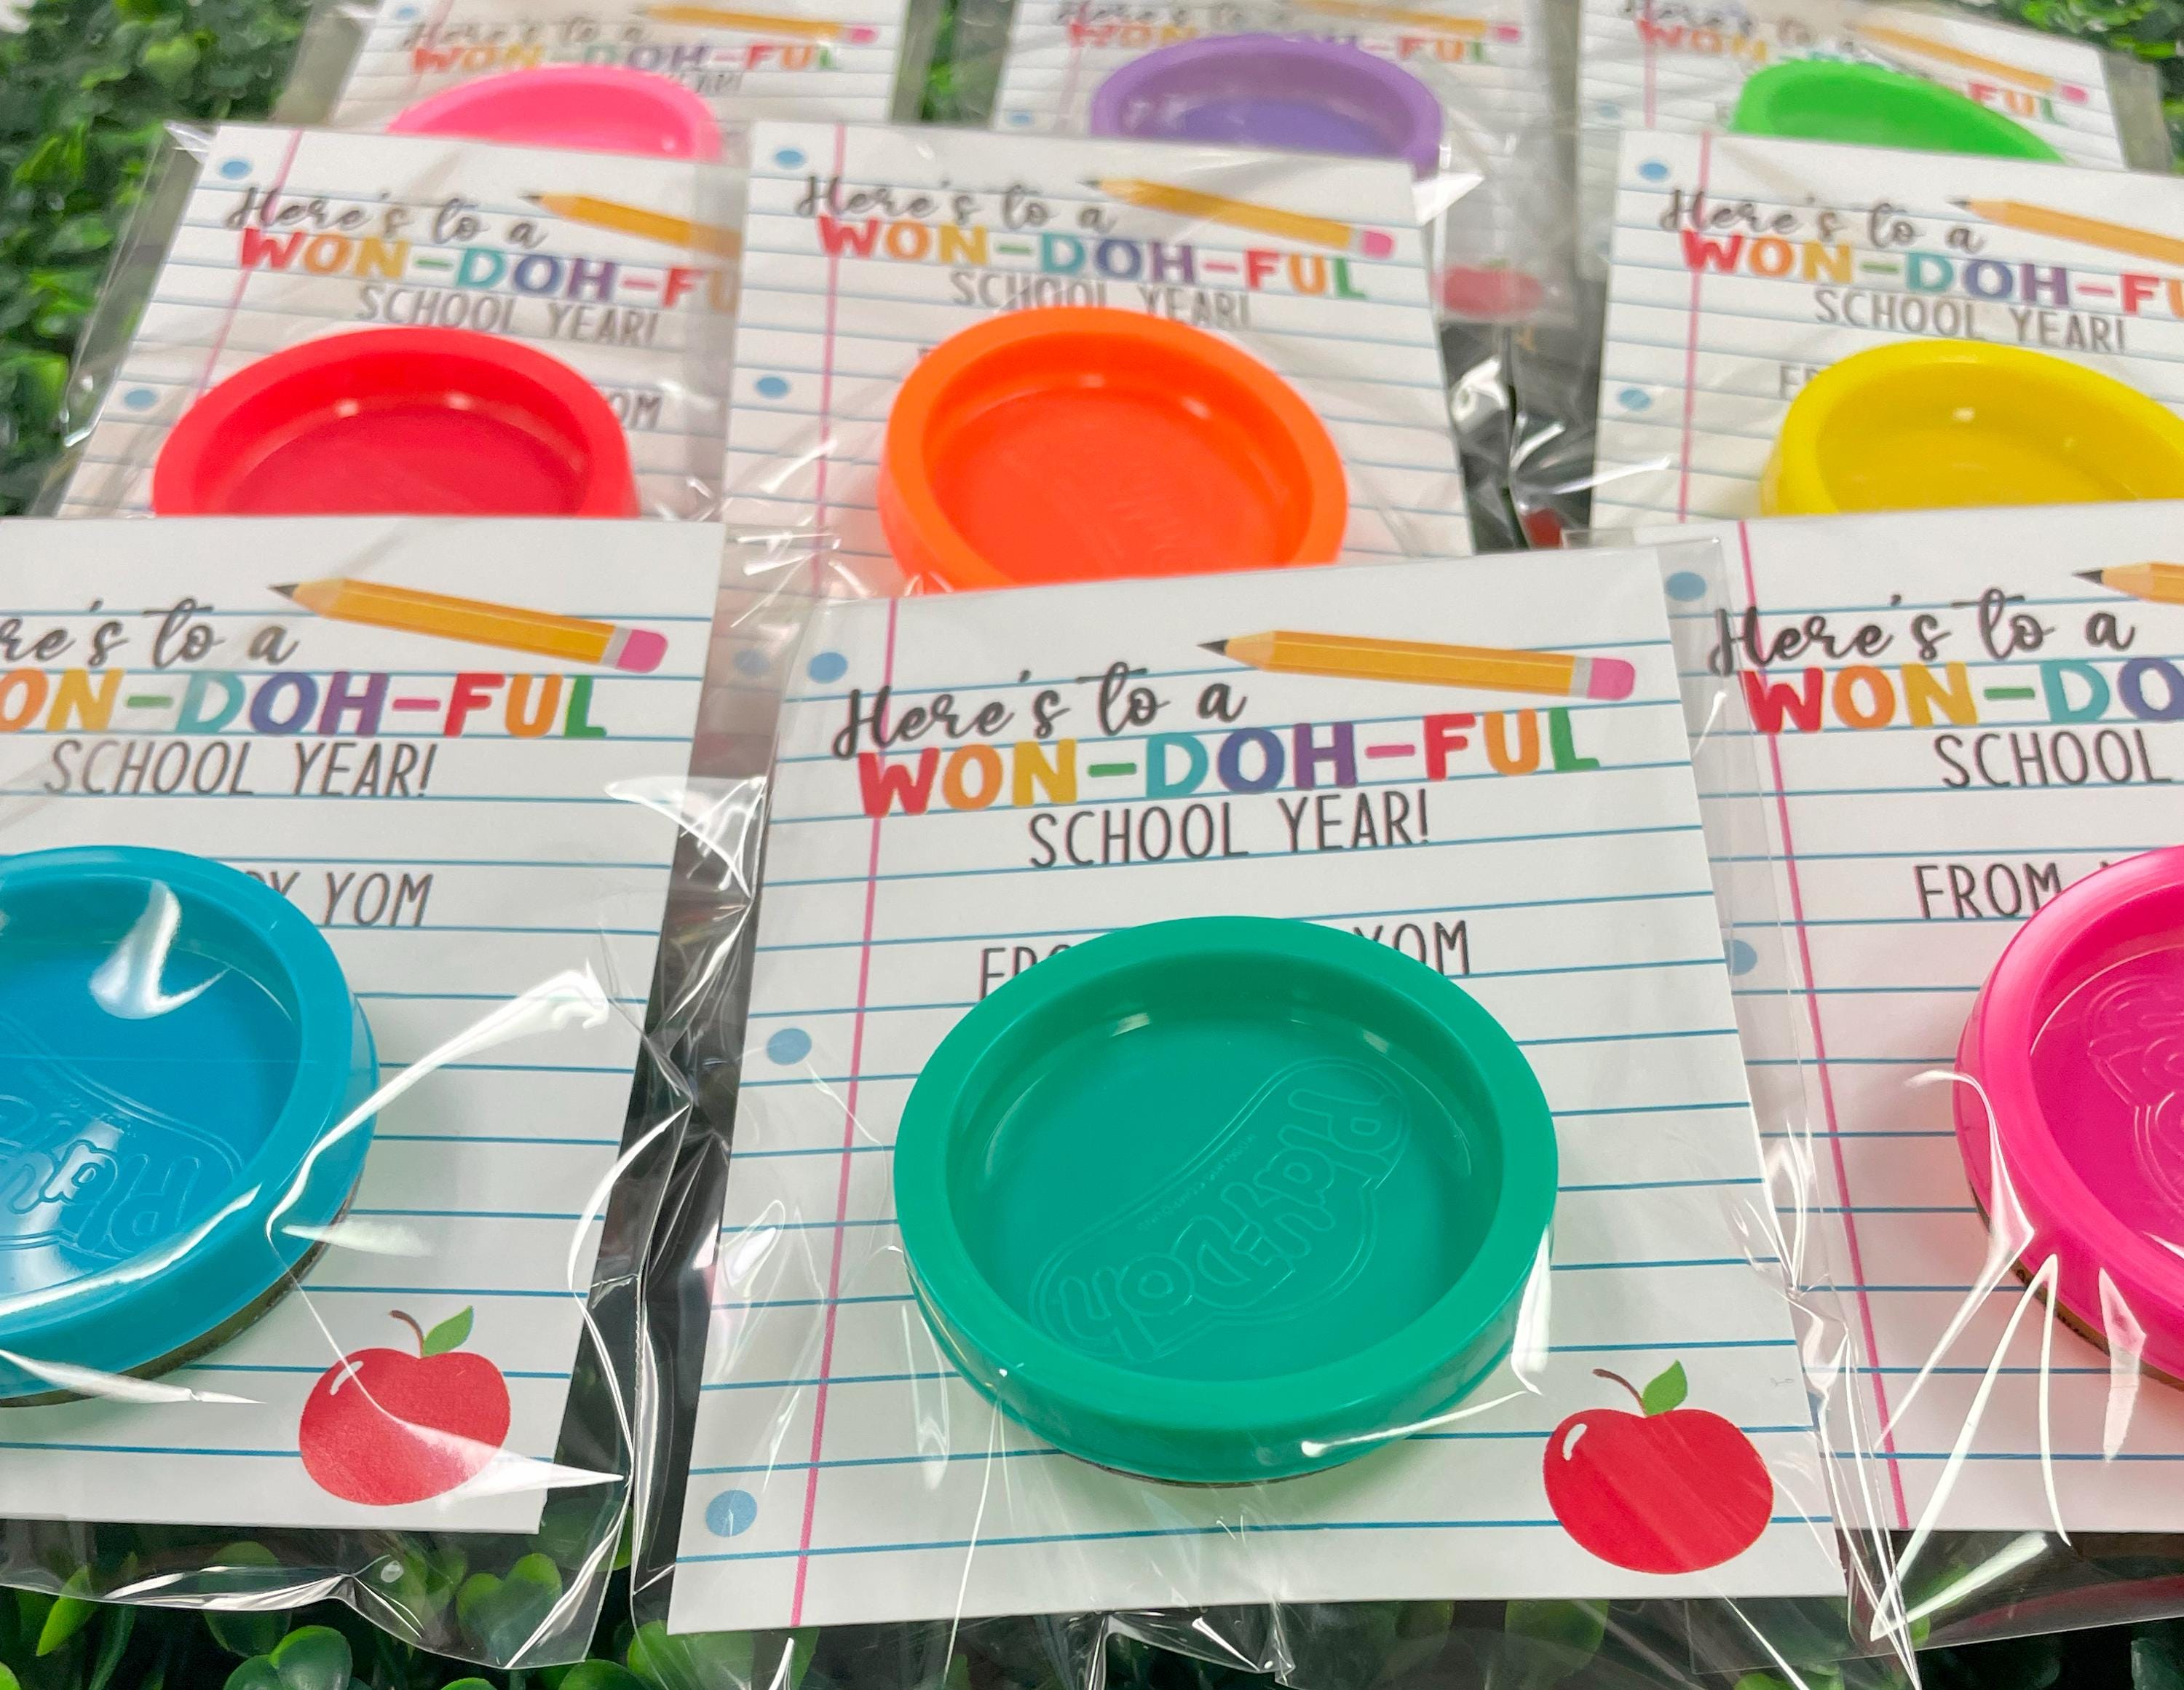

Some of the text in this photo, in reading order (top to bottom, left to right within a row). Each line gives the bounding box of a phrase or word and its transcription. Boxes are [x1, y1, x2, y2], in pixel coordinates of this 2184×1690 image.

[225, 186, 549, 250] Here's to a
[794, 175, 1118, 234] Here's to a
[1658, 187, 1989, 255] Here's to a
[239, 226, 738, 313] WON-DOH-FU
[817, 213, 1369, 301] WON-DOH-FUL
[1813, 288, 2128, 355] SCHOOL YEAR!
[142, 596, 226, 670] to
[248, 622, 303, 666] a
[1706, 585, 2137, 678] Here's to a
[0, 667, 609, 739] ON-DOH-FUL
[832, 661, 1249, 762] Here's to a
[44, 740, 439, 798] SCHOOL YEAR!
[857, 706, 1599, 819] WON-DOH-FUL
[1933, 728, 2172, 788] SCHOOL
[1027, 789, 1429, 869] SCHOOL YEAR!
[324, 872, 433, 927] YOM
[1913, 862, 2062, 919] FROM
